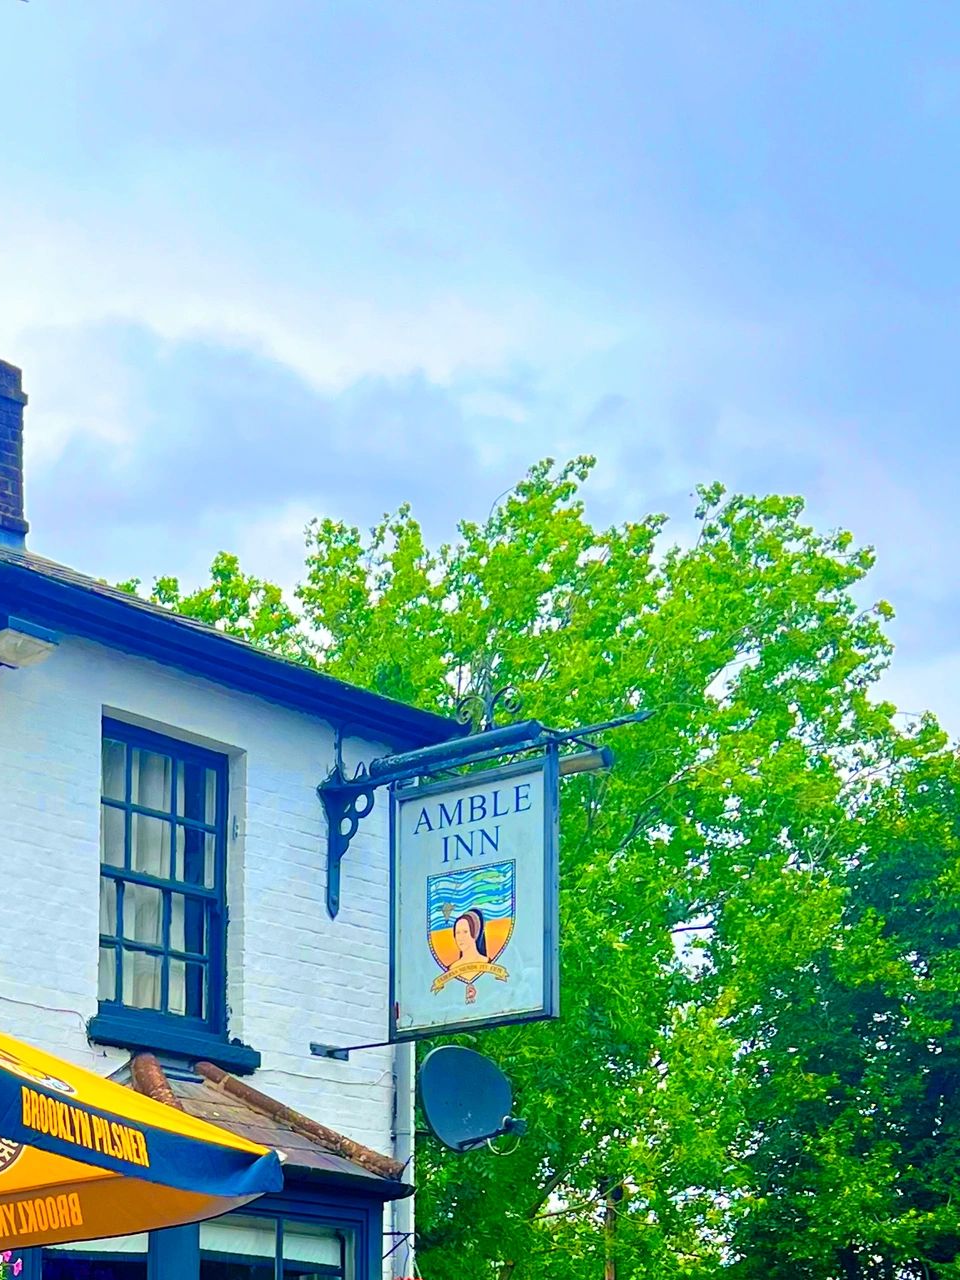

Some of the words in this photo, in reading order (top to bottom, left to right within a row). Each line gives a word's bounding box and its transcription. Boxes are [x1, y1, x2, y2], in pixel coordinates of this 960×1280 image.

[413, 783, 533, 835] AMBLE
[442, 825, 500, 863] INN
[21, 1085, 94, 1150] BROOKLYN
[92, 1116, 150, 1168] PILSNER
